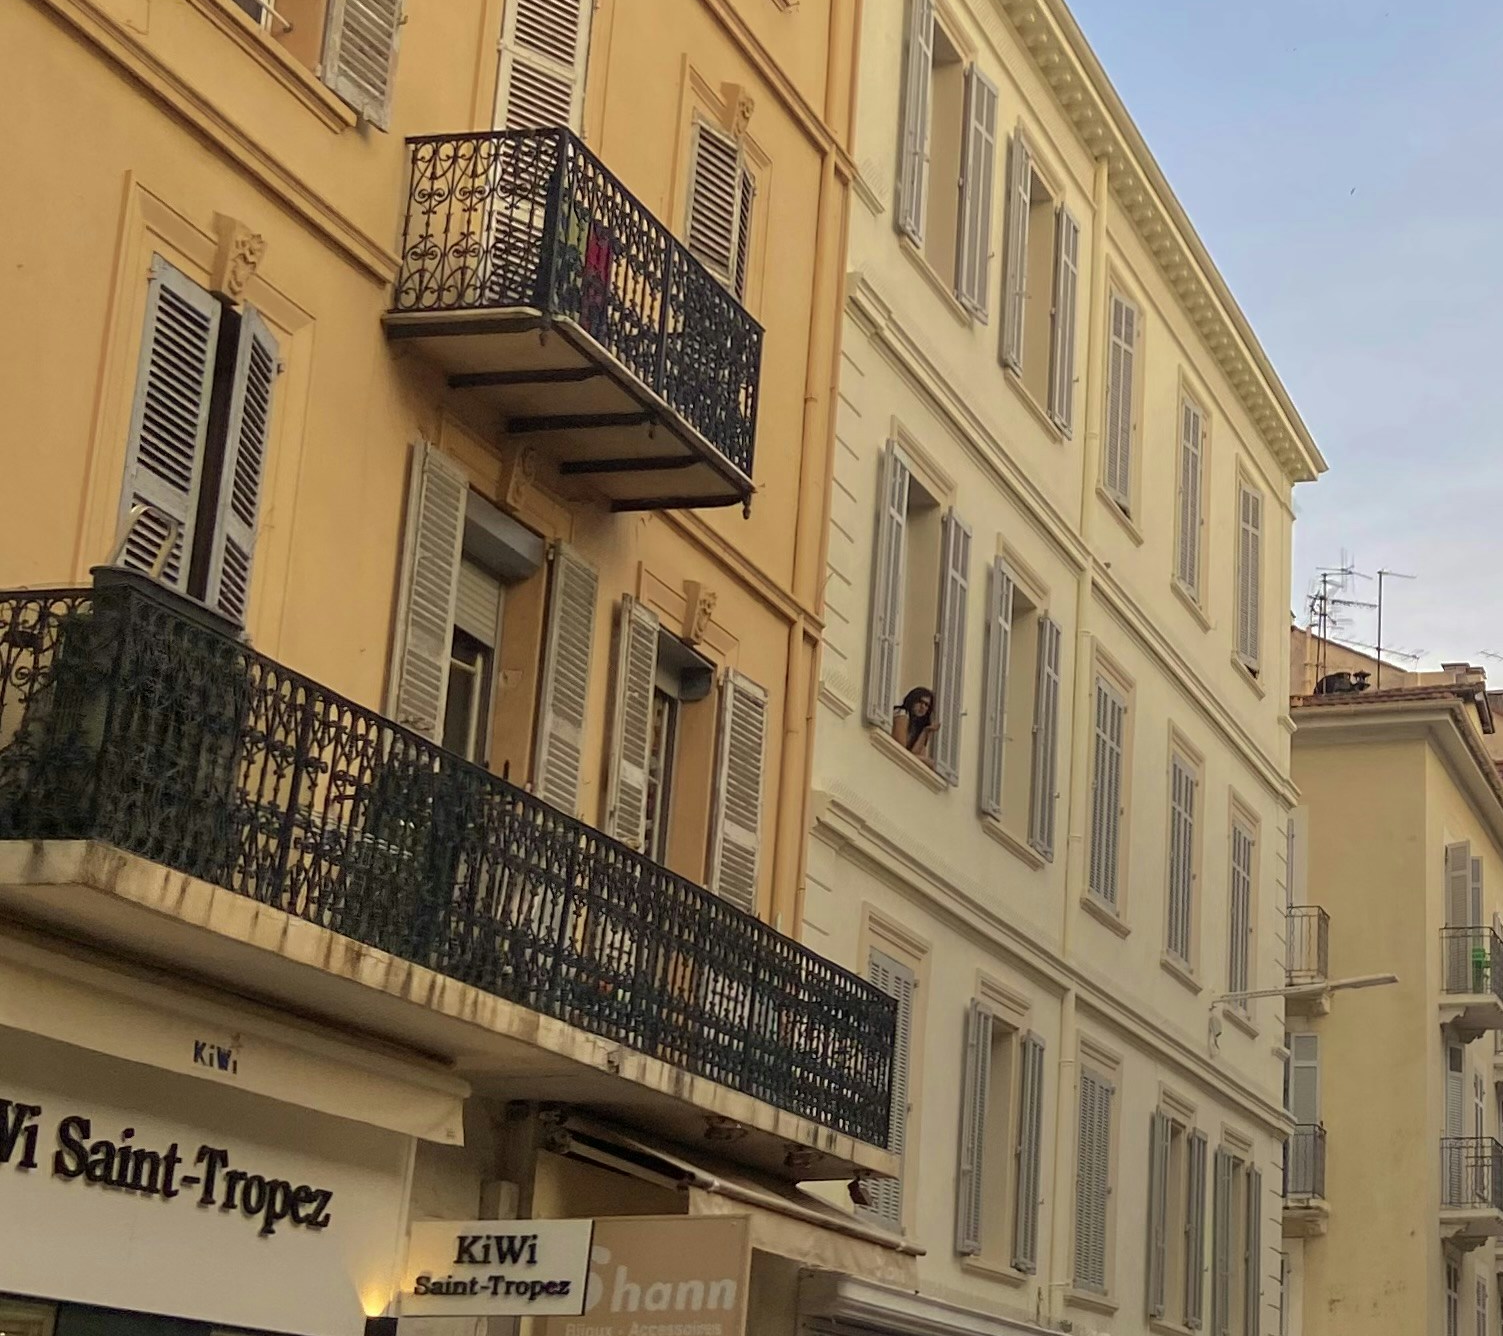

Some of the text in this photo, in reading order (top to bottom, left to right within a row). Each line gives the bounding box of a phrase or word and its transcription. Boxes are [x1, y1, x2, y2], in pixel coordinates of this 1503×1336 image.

[193, 1040, 238, 1074] KiWi
[54, 1115, 333, 1235] Saint-Tropez
[454, 1234, 538, 1265] KiWi
[414, 1275, 571, 1301] Saint-Tropez
